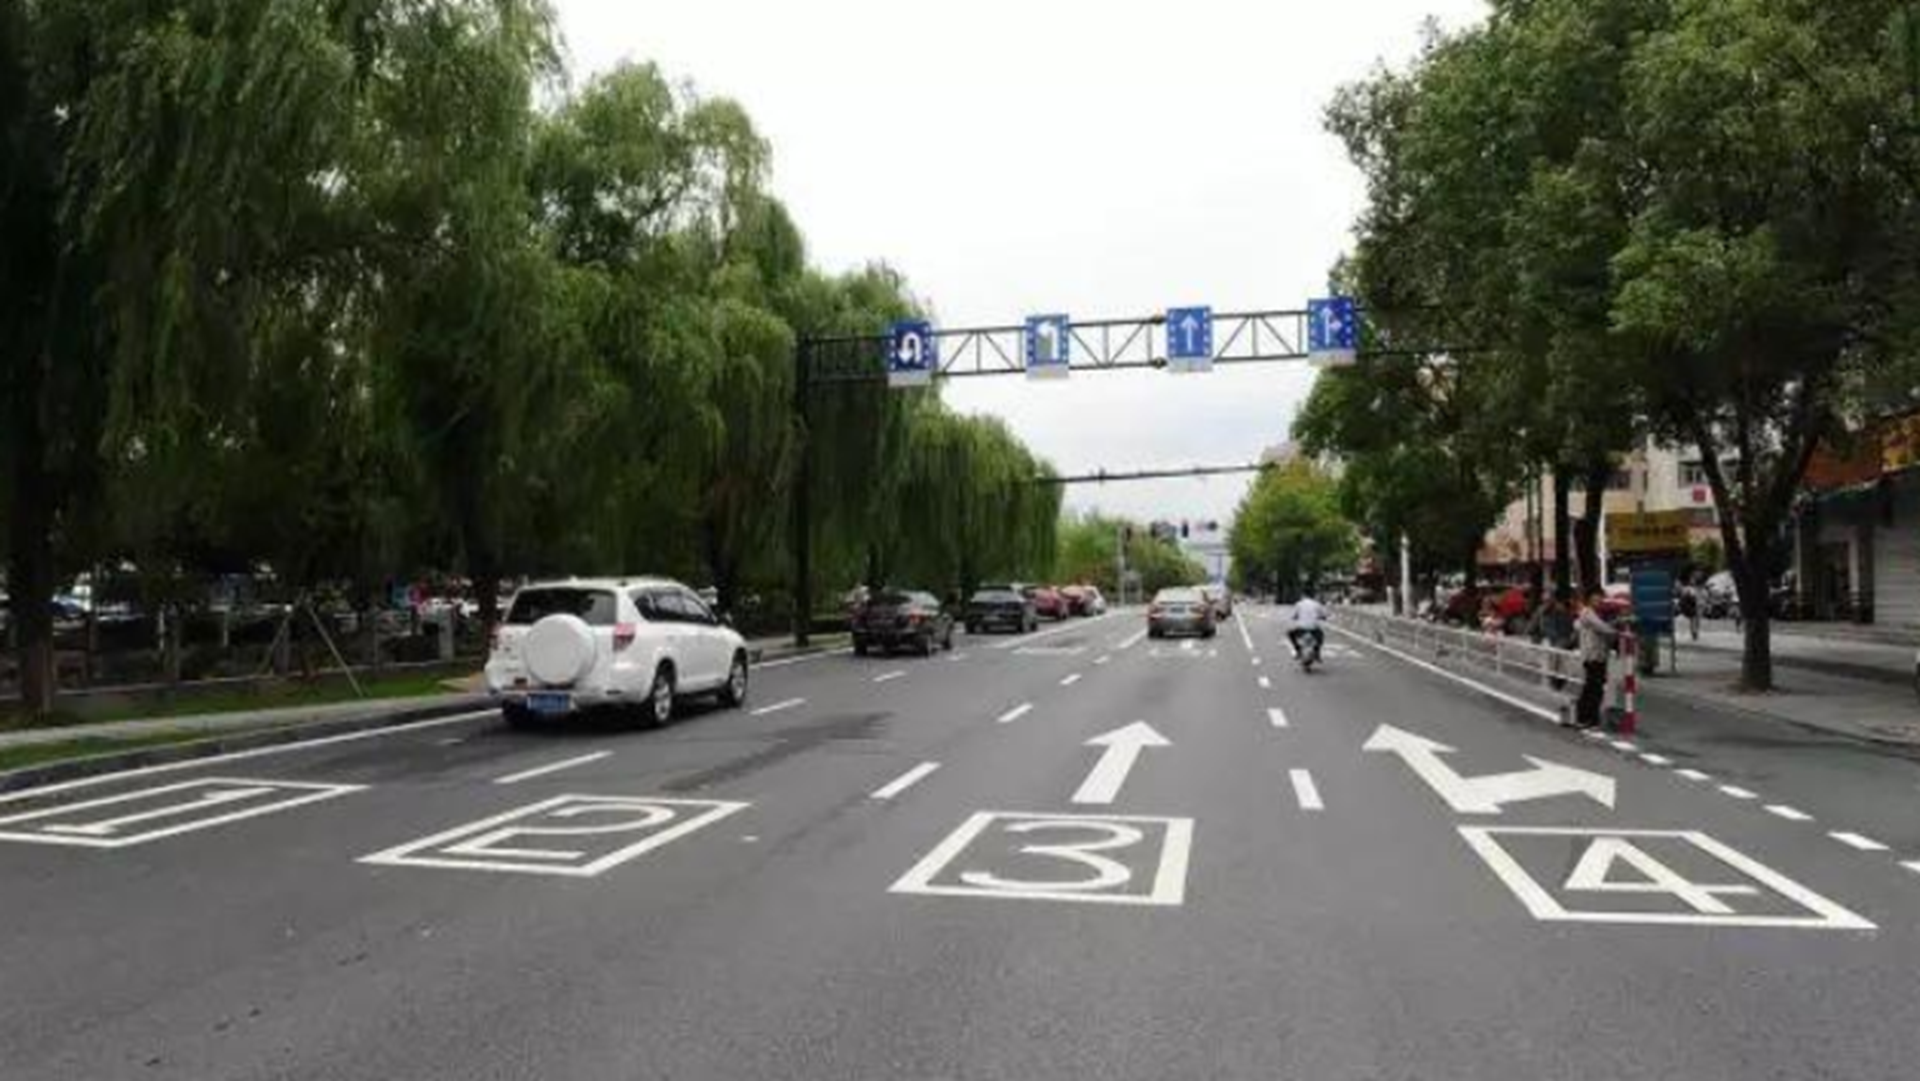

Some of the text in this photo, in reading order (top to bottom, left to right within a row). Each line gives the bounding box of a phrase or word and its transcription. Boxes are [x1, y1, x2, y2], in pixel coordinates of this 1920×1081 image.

[41, 786, 276, 835] 1
[439, 804, 676, 860] 2
[960, 819, 1143, 890] 3
[1564, 837, 1759, 914] 4
